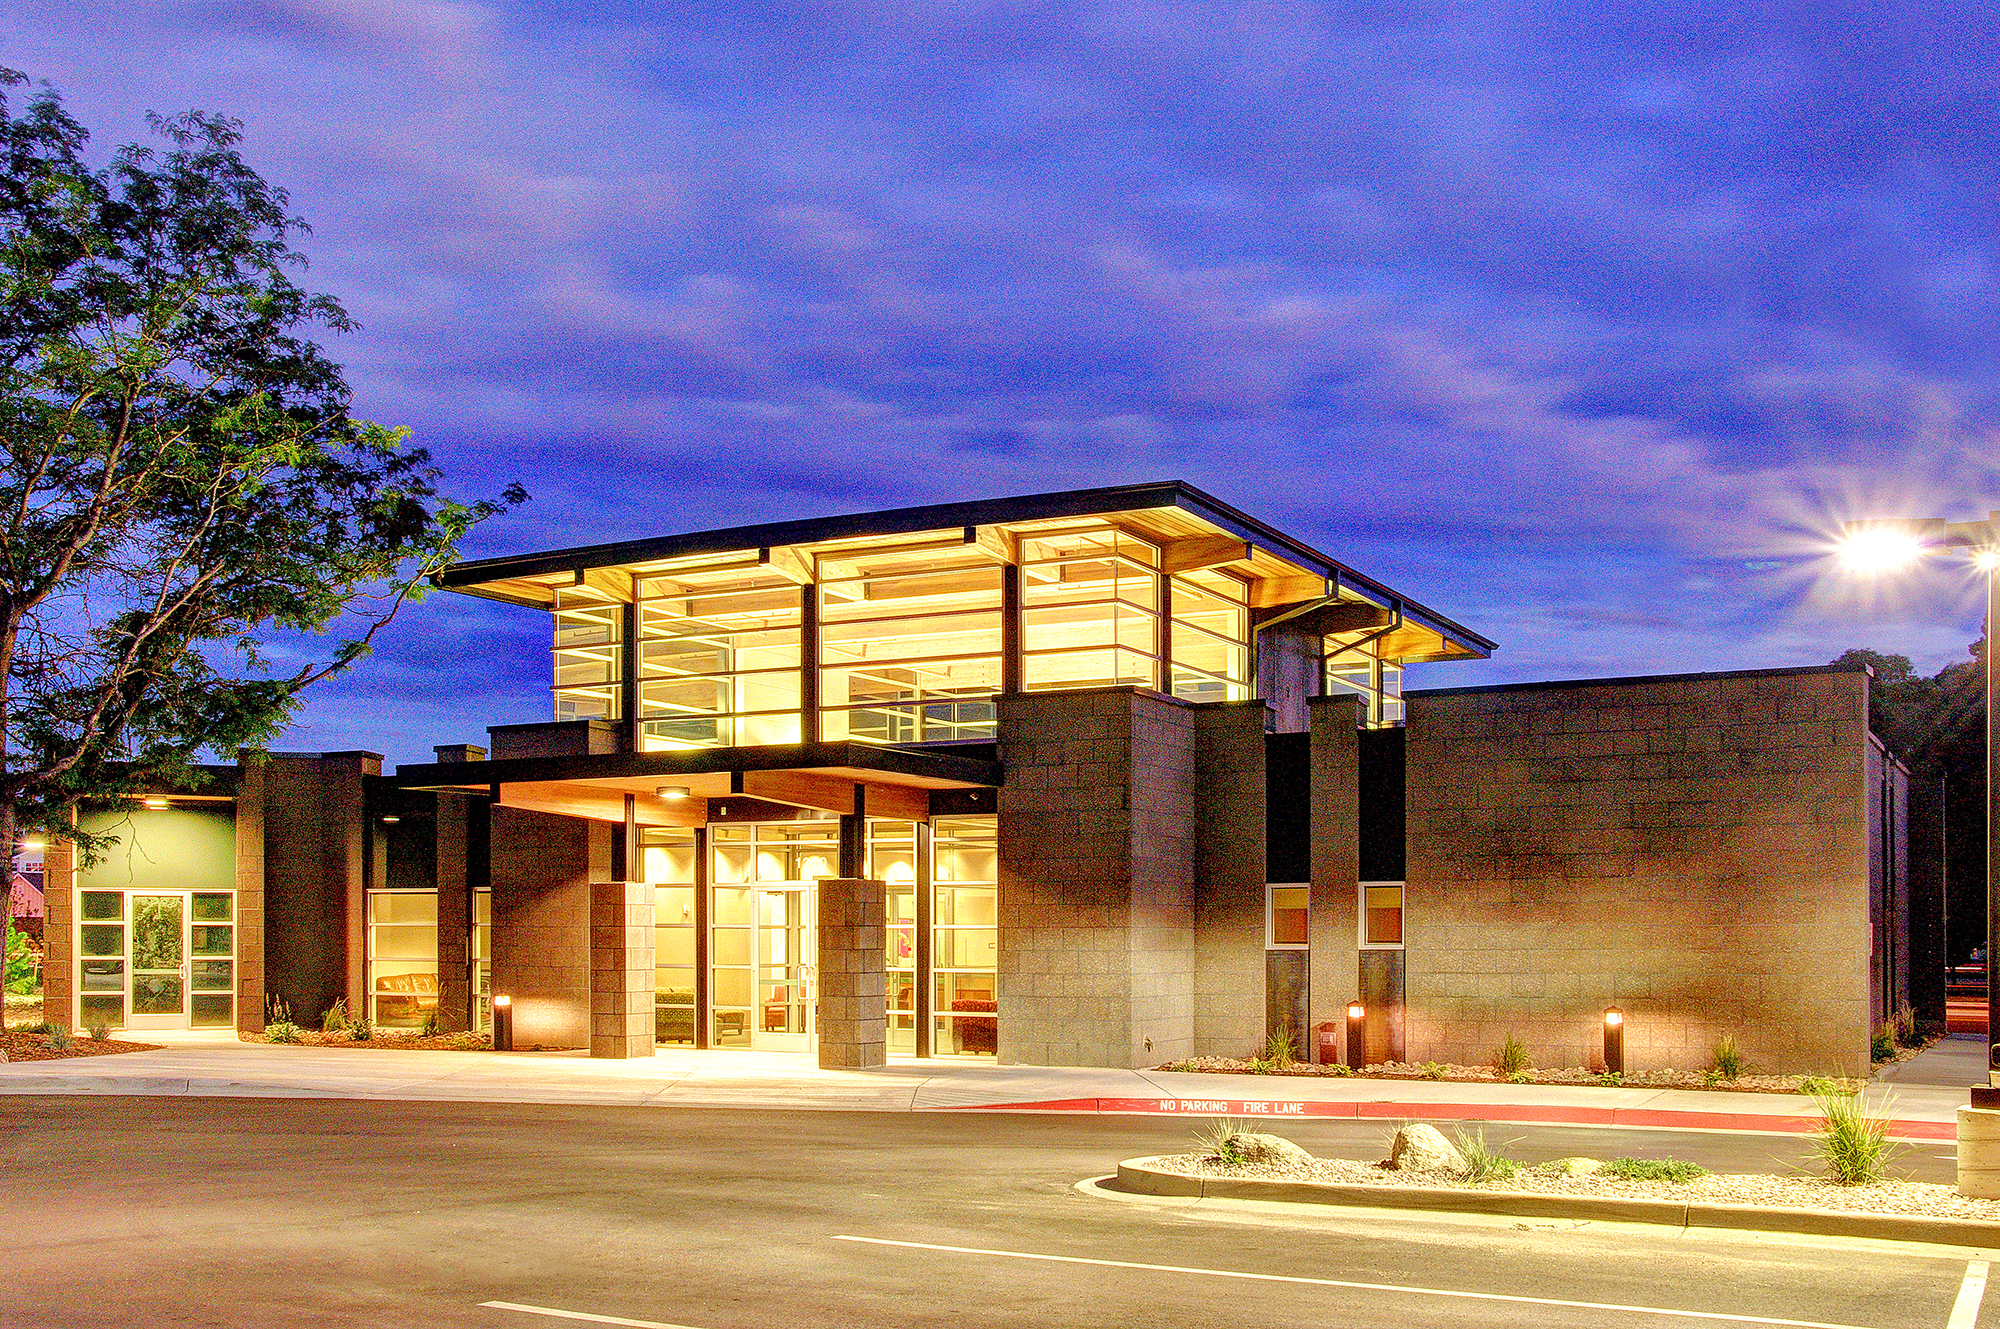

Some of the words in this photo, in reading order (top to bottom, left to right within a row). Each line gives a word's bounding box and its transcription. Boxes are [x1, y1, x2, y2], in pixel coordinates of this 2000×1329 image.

[1160, 1100, 1176, 1111] NO
[1180, 1100, 1228, 1112] PARKING
[1243, 1102, 1270, 1114] FIRE
[1274, 1103, 1305, 1114] LANE
